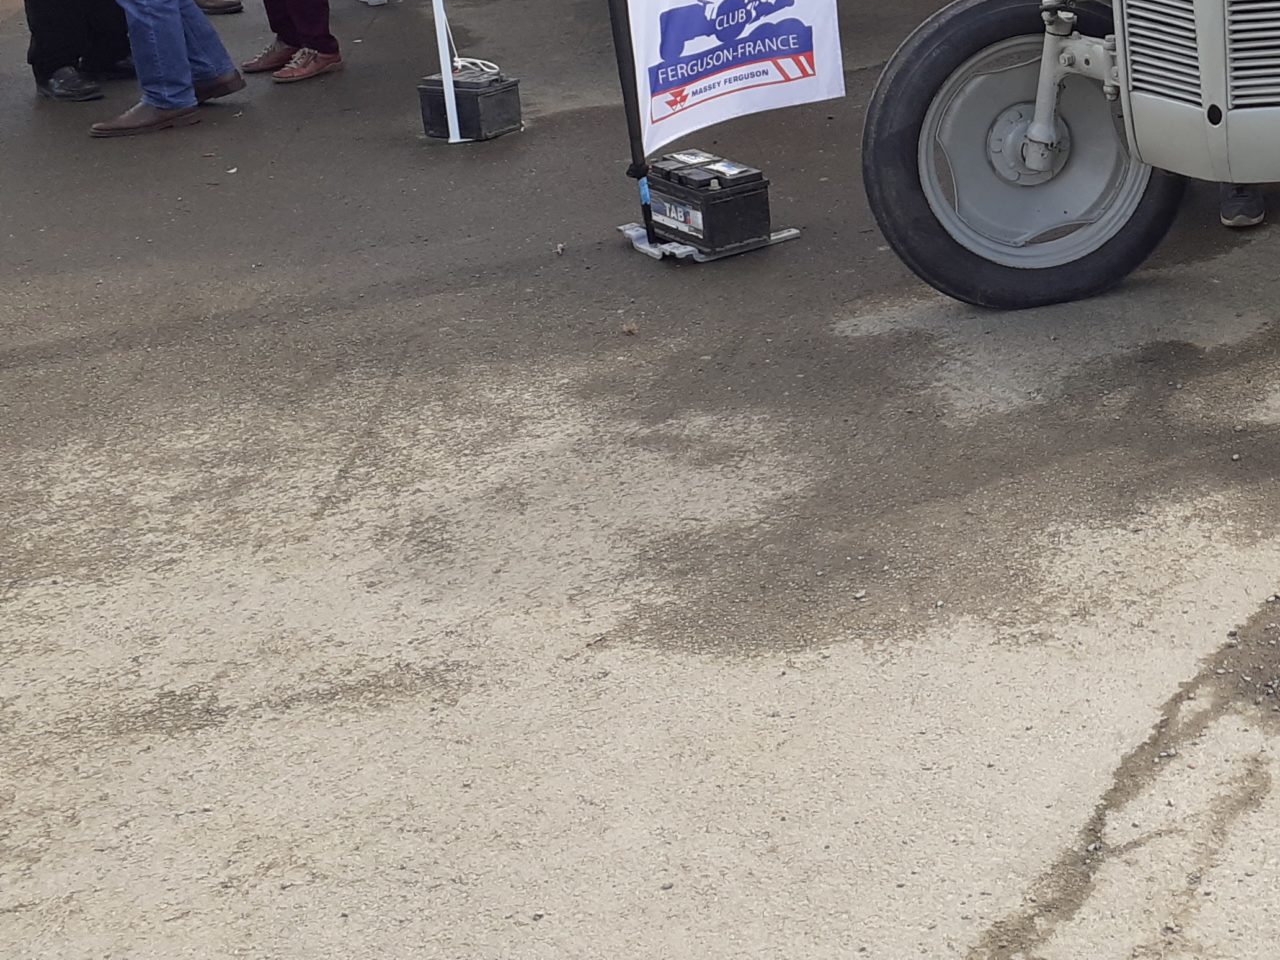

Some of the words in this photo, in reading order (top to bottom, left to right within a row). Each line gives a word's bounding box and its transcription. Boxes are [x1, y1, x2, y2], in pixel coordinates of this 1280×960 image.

[715, 9, 747, 30] CLUB
[657, 34, 800, 85] FERGUSON-FRANCE
[691, 81, 721, 97] MASSEY
[723, 69, 769, 86] FERGUSON
[663, 201, 685, 222] TAB
